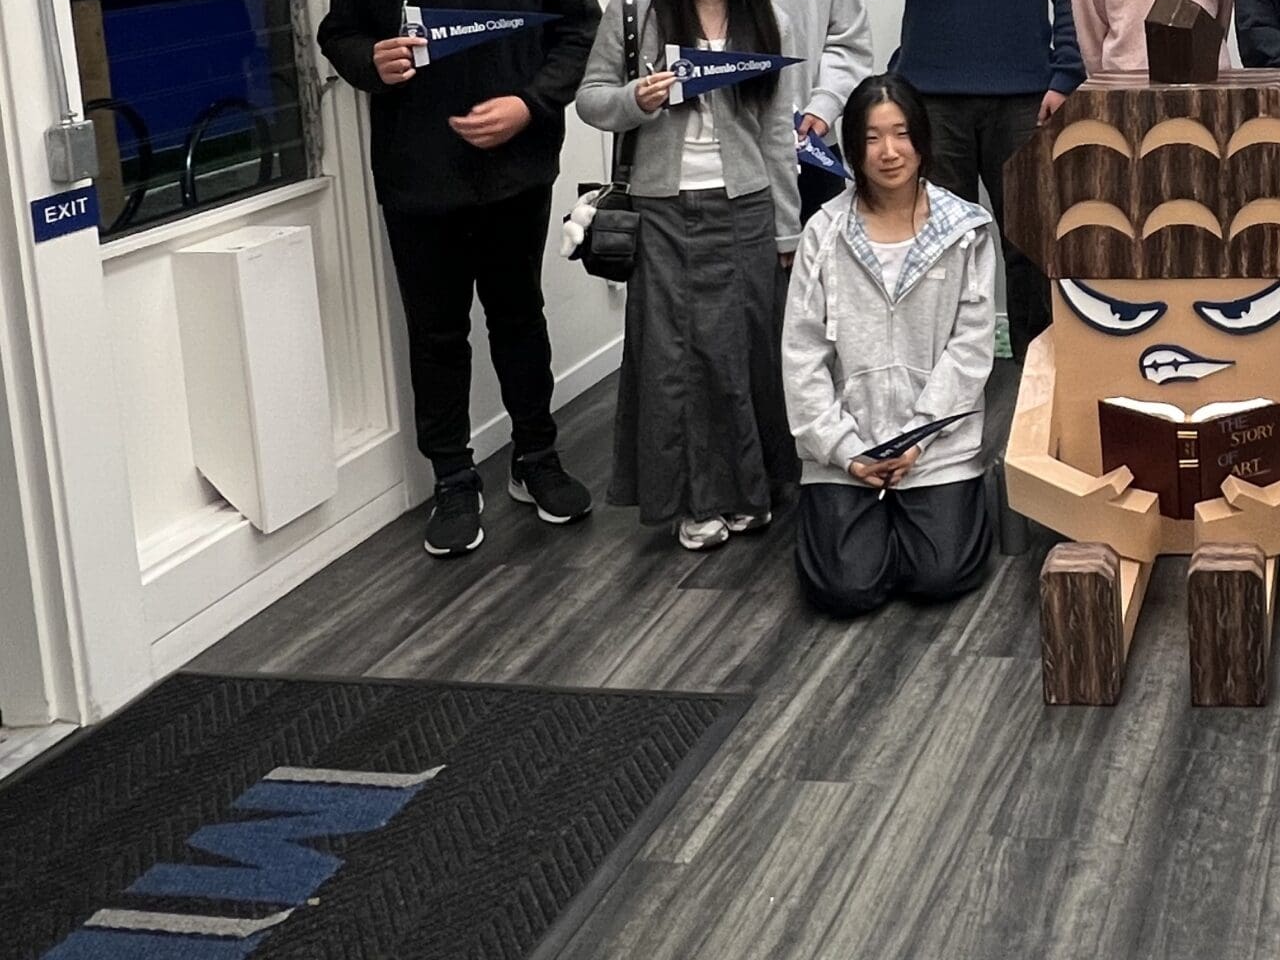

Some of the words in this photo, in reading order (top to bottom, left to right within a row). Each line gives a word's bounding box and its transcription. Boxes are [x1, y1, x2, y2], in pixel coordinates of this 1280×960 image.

[430, 26, 448, 40] M
[450, 22, 486, 37] Menlo
[486, 17, 524, 31] College
[703, 63, 736, 76] Menlo
[736, 60, 772, 72] College
[44, 197, 89, 224] EXIT
[1218, 416, 1249, 434] THE
[1230, 423, 1275, 447] STORY
[1217, 450, 1239, 468] OF
[1231, 458, 1261, 476] ART
